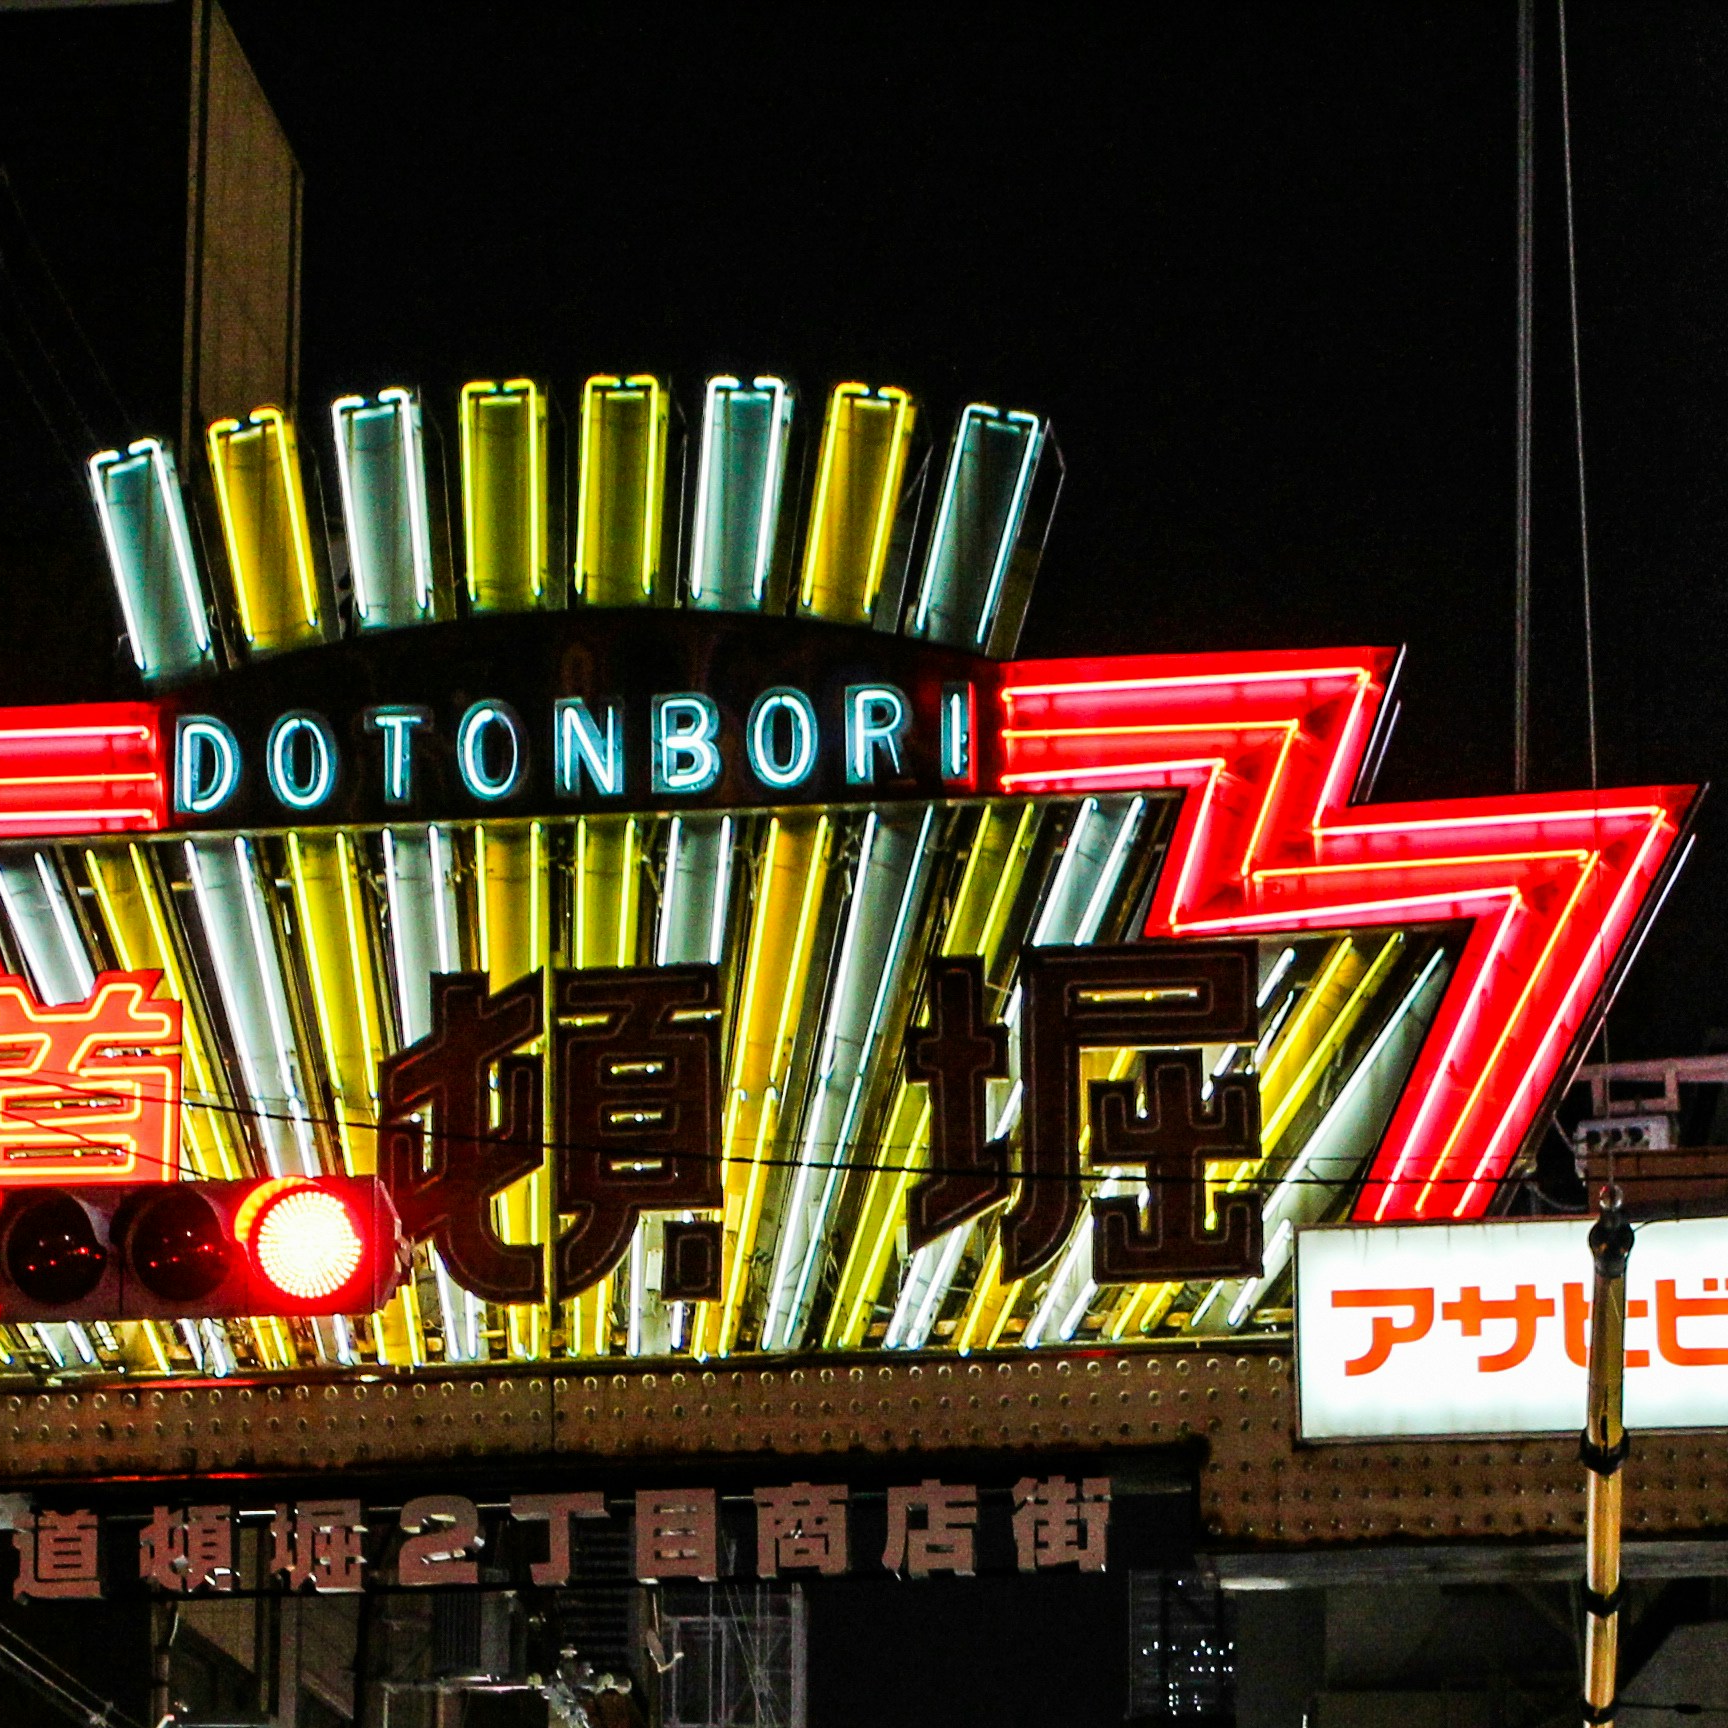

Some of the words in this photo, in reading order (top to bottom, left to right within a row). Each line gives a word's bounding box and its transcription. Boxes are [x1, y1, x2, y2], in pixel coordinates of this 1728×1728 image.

[173, 678, 972, 815] DOTONBORI
[12, 1477, 1111, 1602] 道頓堀2丁目商店街
